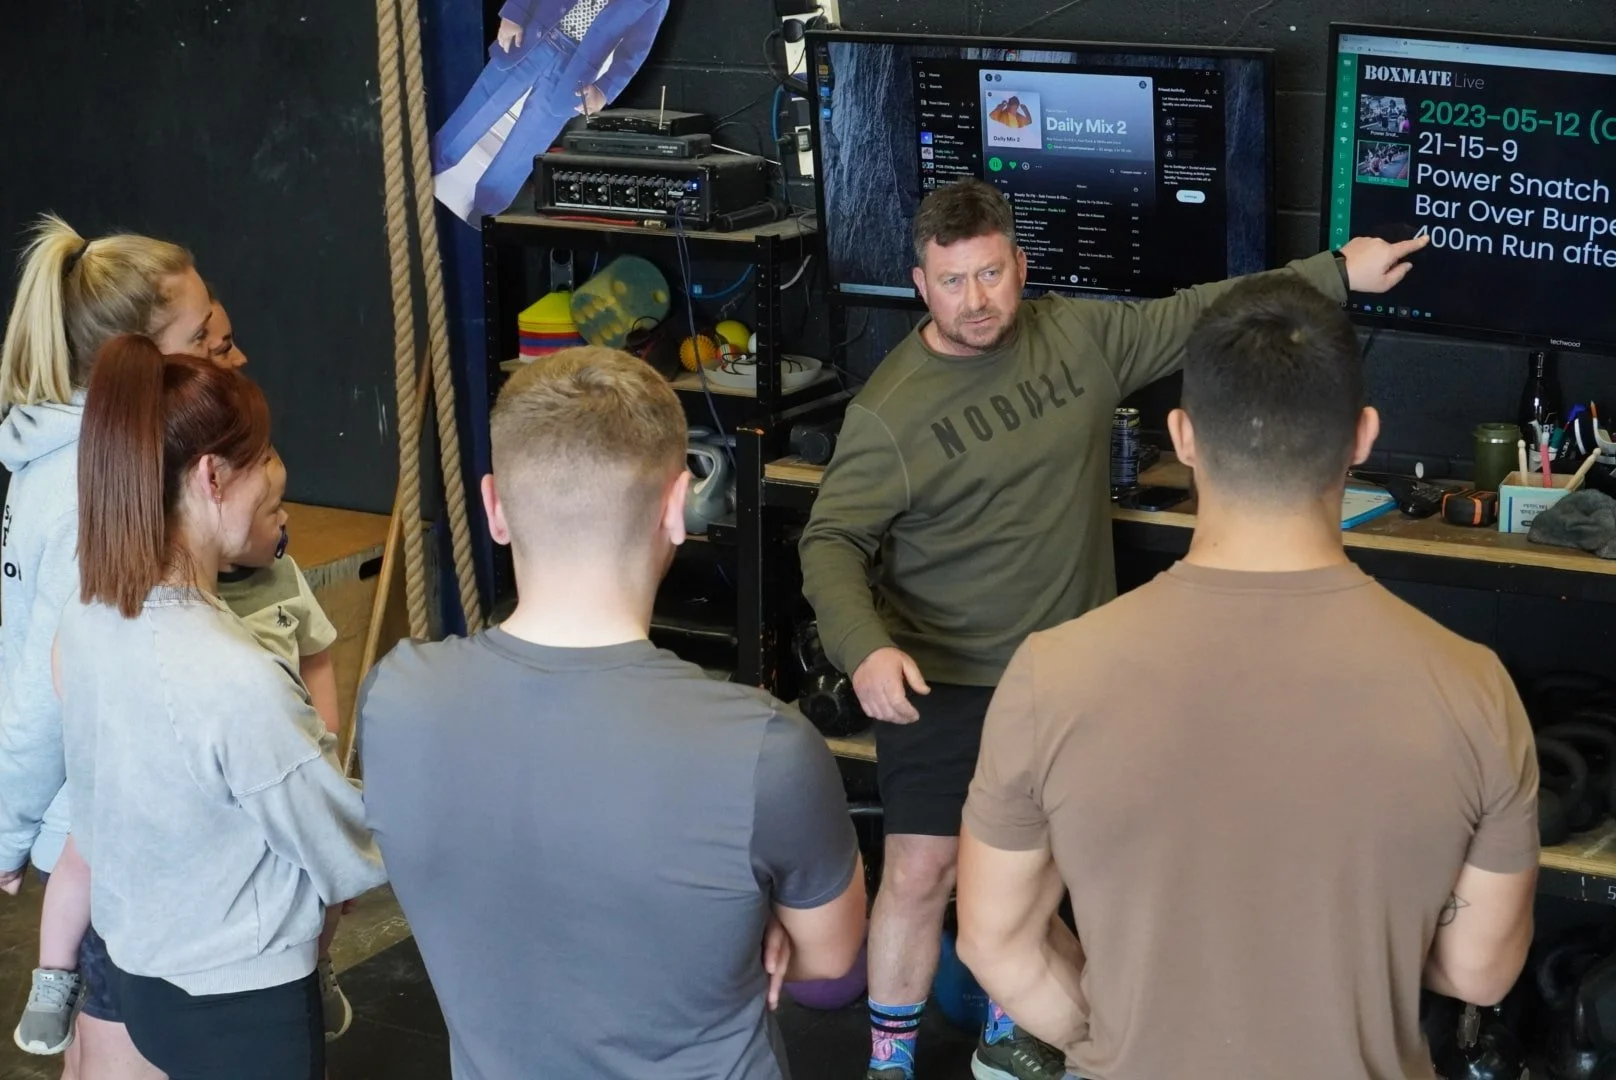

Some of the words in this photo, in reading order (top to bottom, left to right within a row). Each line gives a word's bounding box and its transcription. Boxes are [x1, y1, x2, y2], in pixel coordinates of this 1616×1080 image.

[1364, 64, 1452, 87] BOXMATE
[1454, 72, 1485, 90] Live
[1046, 116, 1083, 135] Daily
[1086, 118, 1114, 134] Mix
[1117, 120, 1127, 135] 2
[1418, 99, 1580, 137] 2023-05-12
[1418, 131, 1518, 163] 21-15-9
[1416, 163, 1502, 192] Power
[1509, 172, 1610, 204] Snatch
[1415, 194, 1460, 219] Bar
[1468, 199, 1534, 227] Over
[1502, 234, 1554, 261] Run
[1550, 337, 1581, 348] techwood
